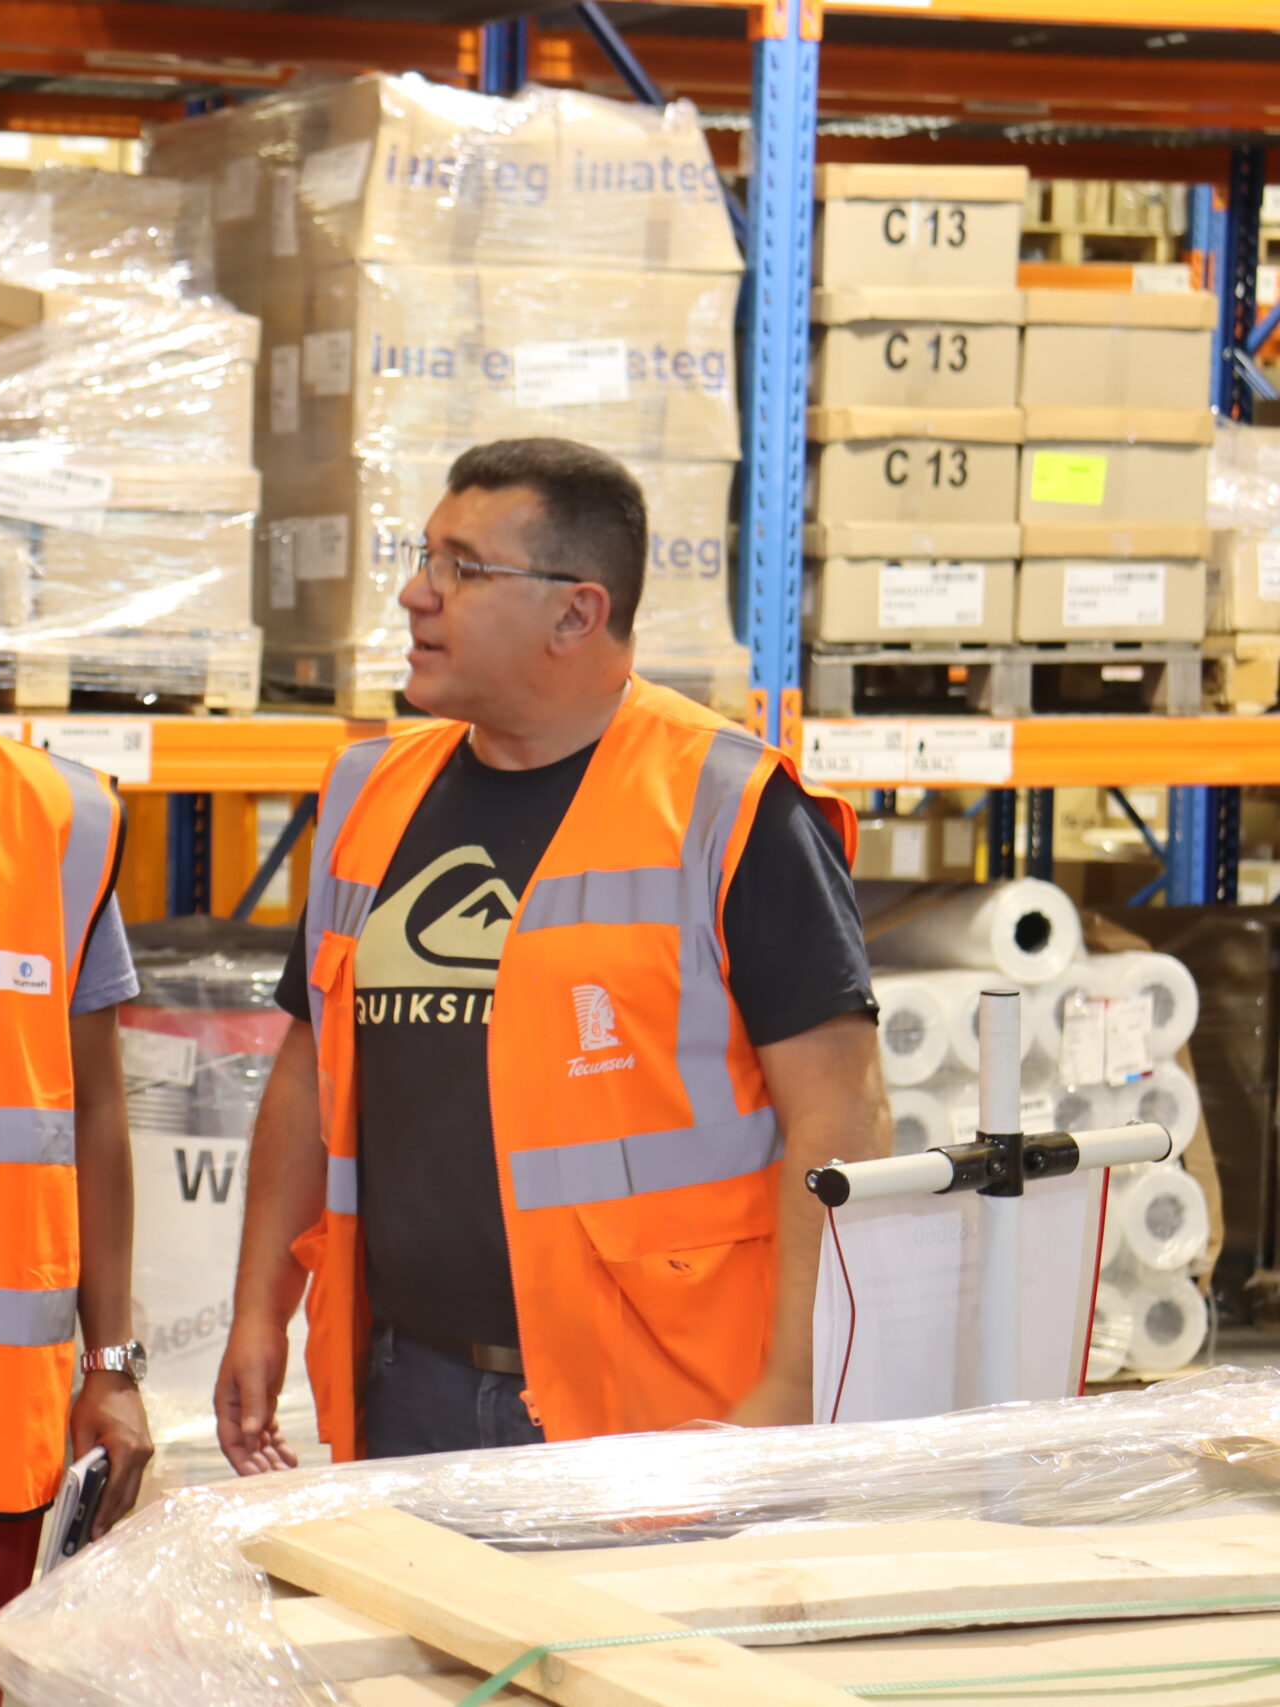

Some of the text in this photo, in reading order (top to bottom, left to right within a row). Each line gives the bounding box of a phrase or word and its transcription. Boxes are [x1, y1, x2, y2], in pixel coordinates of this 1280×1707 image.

[884, 208, 967, 248] C 13
[885, 331, 968, 373] C 13
[885, 448, 968, 488] C 13
[566, 1053, 636, 1078] Tecumseh
